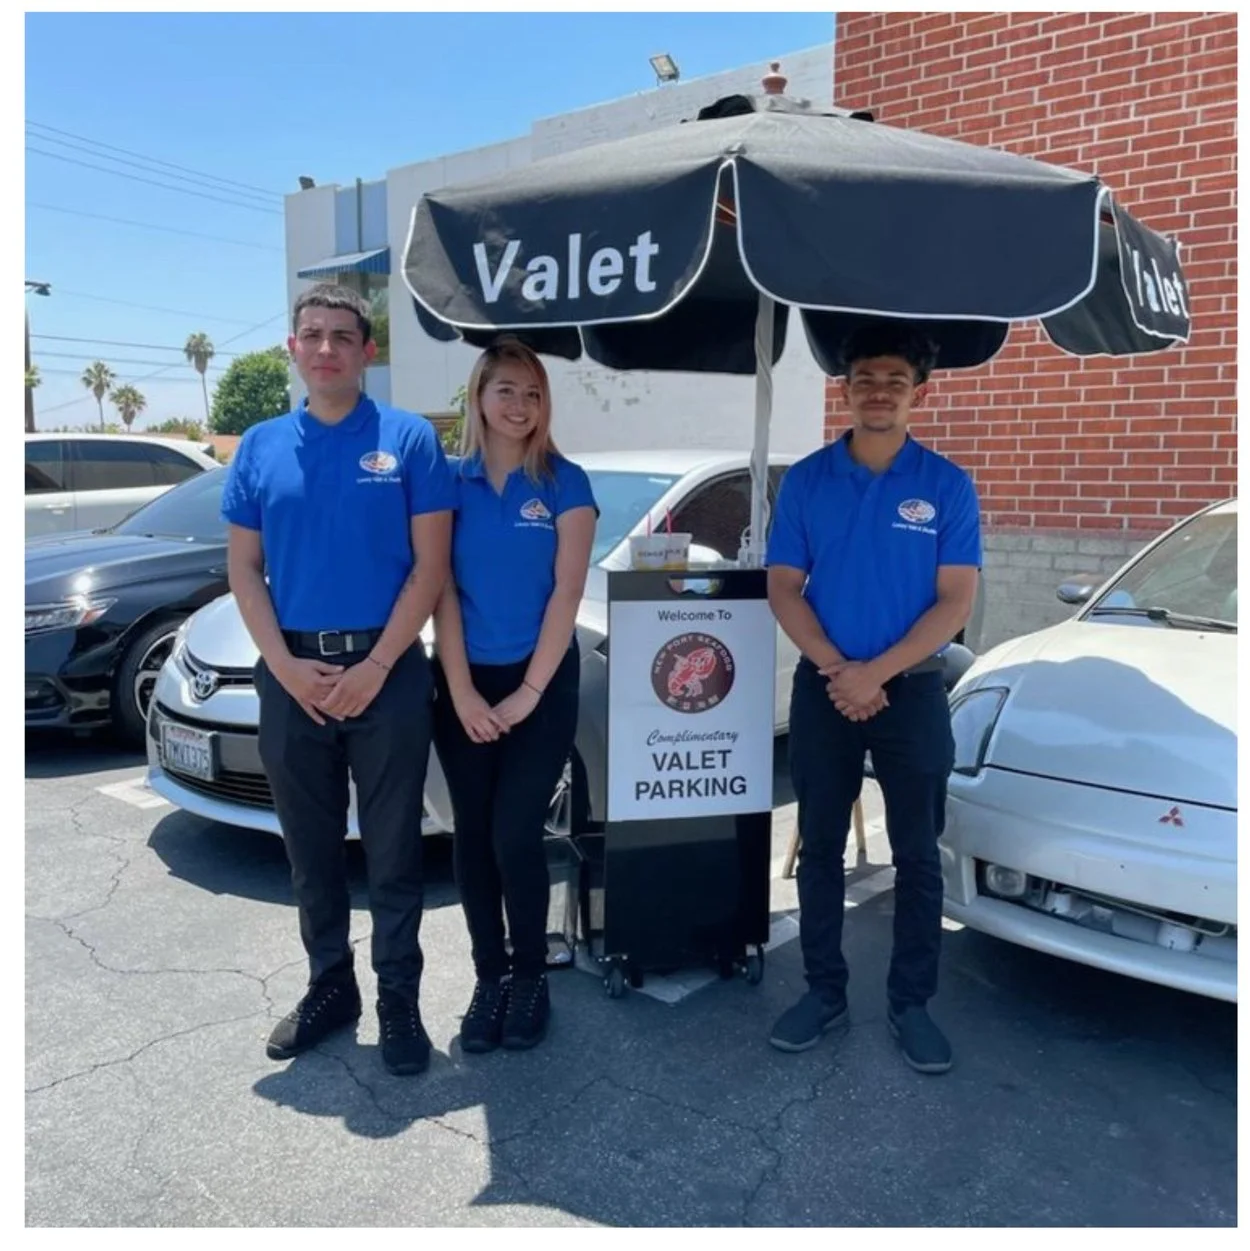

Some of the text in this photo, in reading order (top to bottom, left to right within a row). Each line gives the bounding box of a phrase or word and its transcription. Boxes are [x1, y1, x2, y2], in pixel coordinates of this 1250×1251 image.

[473, 230, 659, 303] Valet
[658, 609, 732, 621] Welcome To
[646, 729, 739, 746] Complimentary
[652, 749, 732, 772] VALET
[635, 776, 747, 801] PARKING
